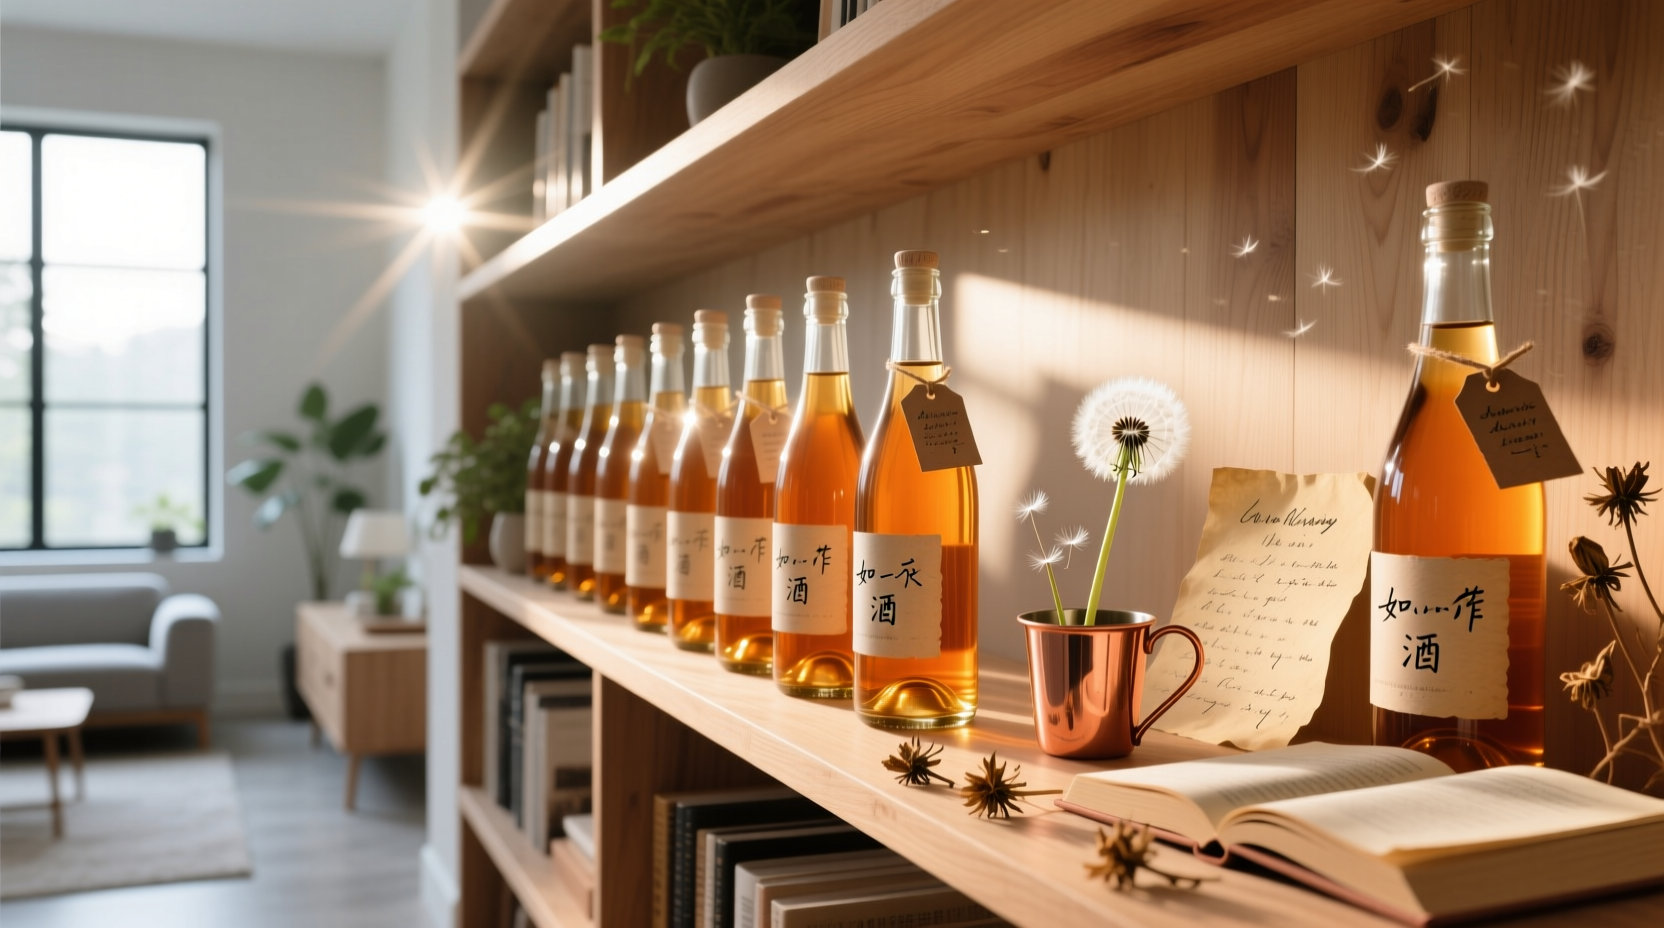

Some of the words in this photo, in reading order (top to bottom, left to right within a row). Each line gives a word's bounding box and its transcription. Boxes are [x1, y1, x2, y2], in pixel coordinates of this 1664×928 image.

[728, 565, 746, 591] 酒
[786, 576, 808, 605] 酒
[871, 594, 897, 626] 酒
[1402, 633, 1440, 674] 酒
